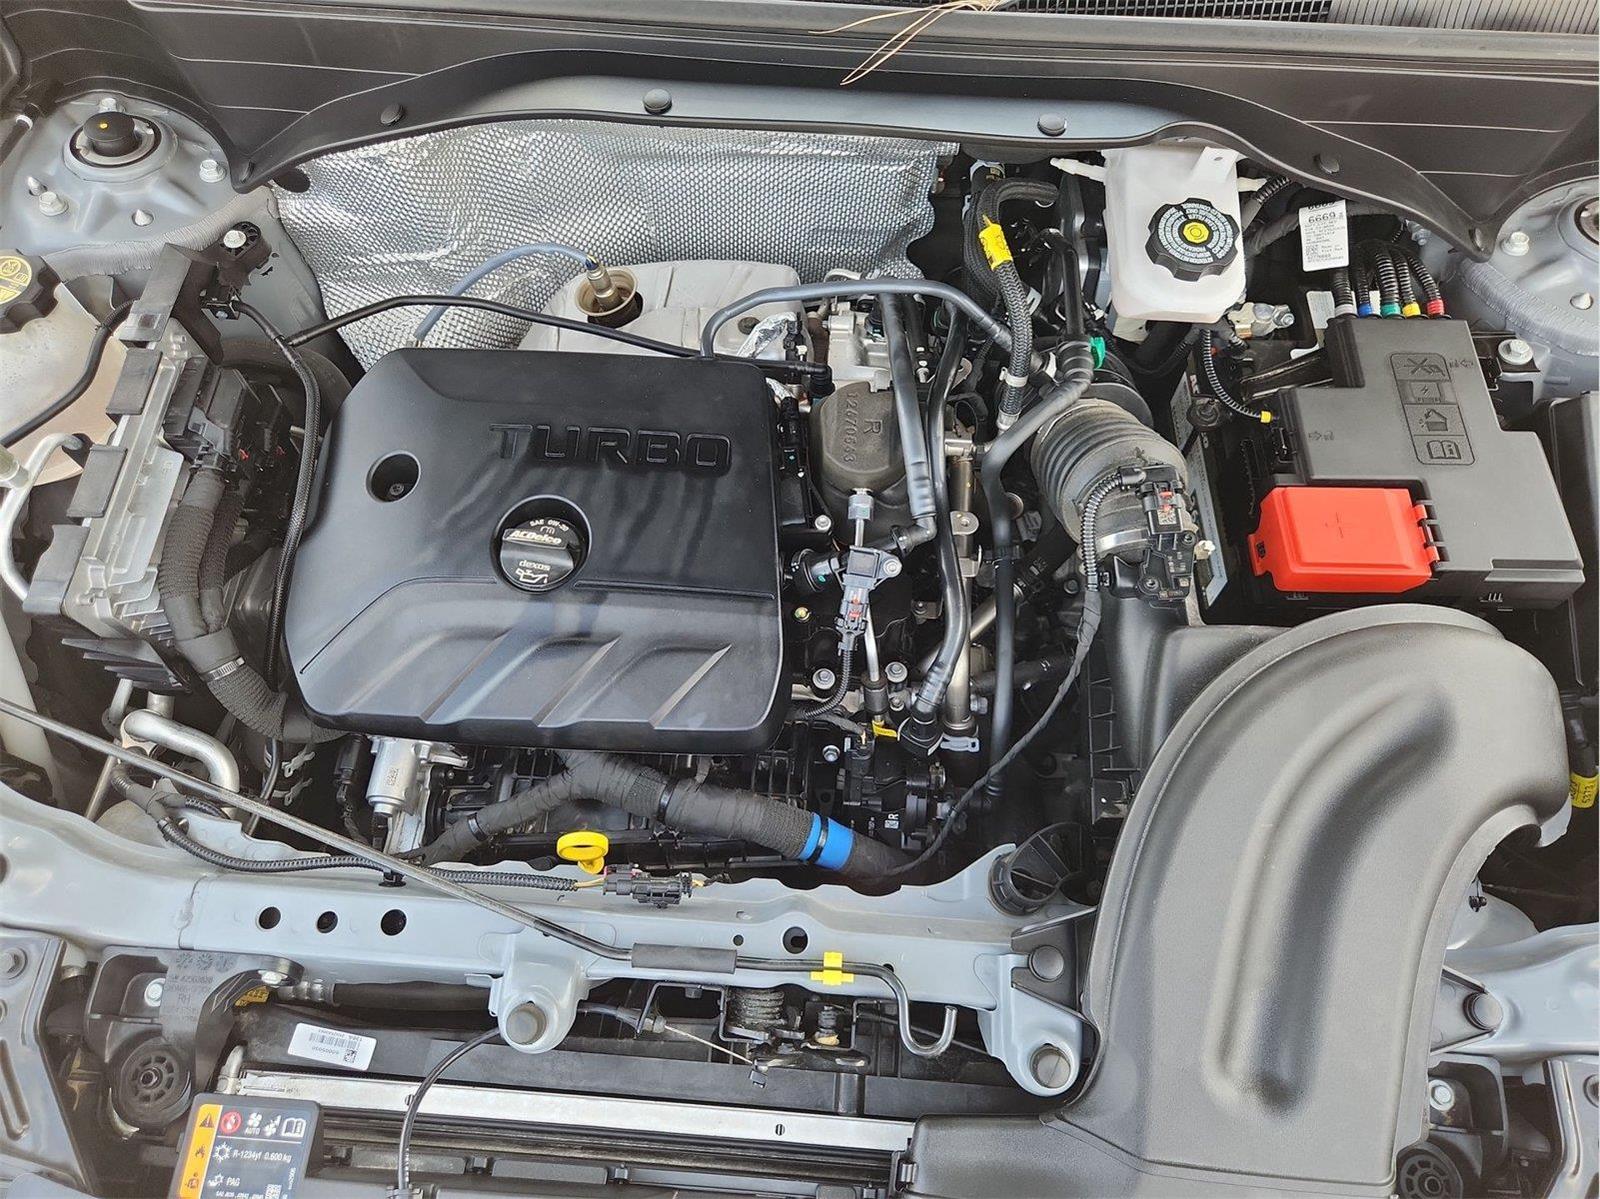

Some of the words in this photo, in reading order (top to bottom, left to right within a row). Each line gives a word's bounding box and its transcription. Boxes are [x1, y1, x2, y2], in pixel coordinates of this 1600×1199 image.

[1308, 211, 1336, 224] 6669
[863, 418, 883, 435] R
[488, 423, 732, 467] TURBO
[529, 519, 545, 527] SAE
[508, 529, 562, 546] ACDelco
[518, 559, 551, 572] dexos
[244, 1127, 261, 1136] AUTO
[232, 1149, 262, 1162] R-1234yf
[263, 1151, 282, 1161] 0.600
[282, 1152, 293, 1164] kg
[225, 1176, 241, 1187] PAG
